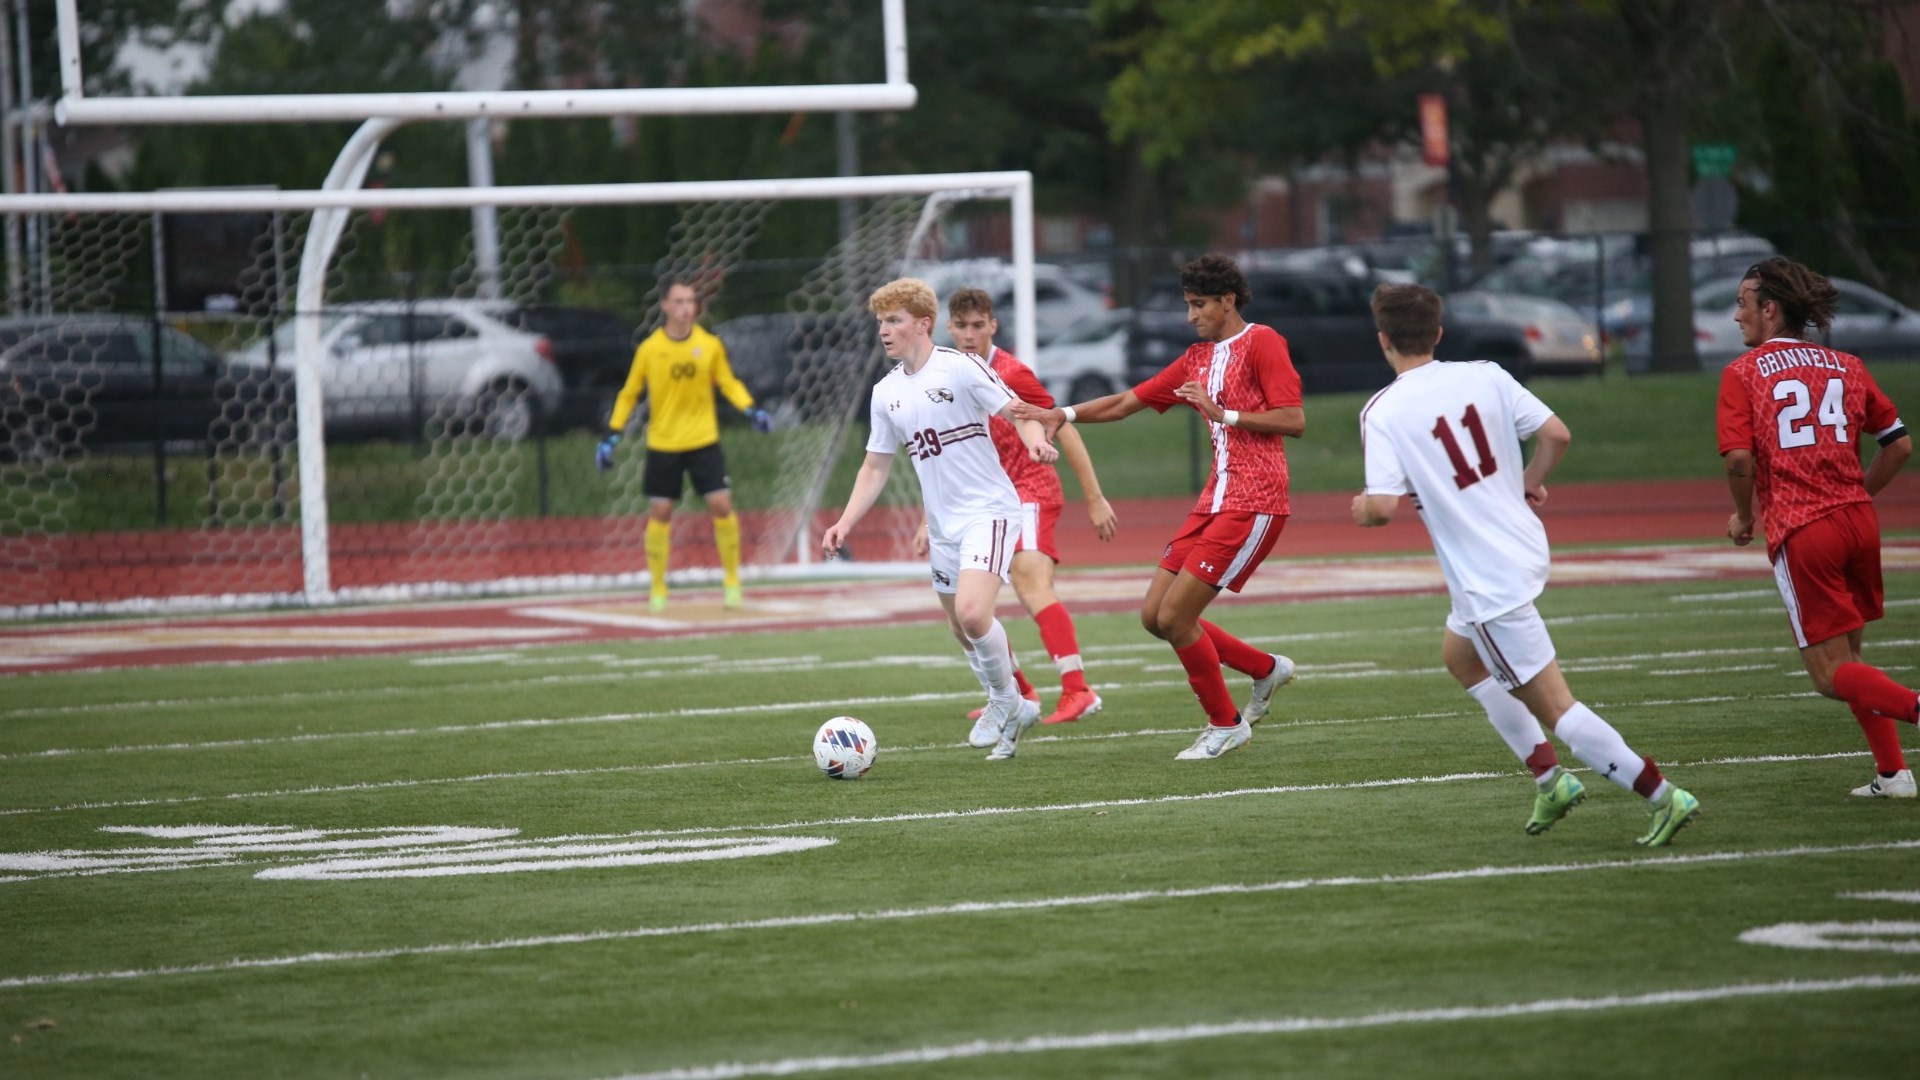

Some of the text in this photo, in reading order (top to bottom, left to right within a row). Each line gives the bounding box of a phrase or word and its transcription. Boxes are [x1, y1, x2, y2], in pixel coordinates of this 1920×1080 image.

[1756, 347, 1847, 378] GRINNELL
[1773, 377, 1849, 449] 24
[913, 427, 942, 461] 29
[1431, 402, 1498, 491] 11
